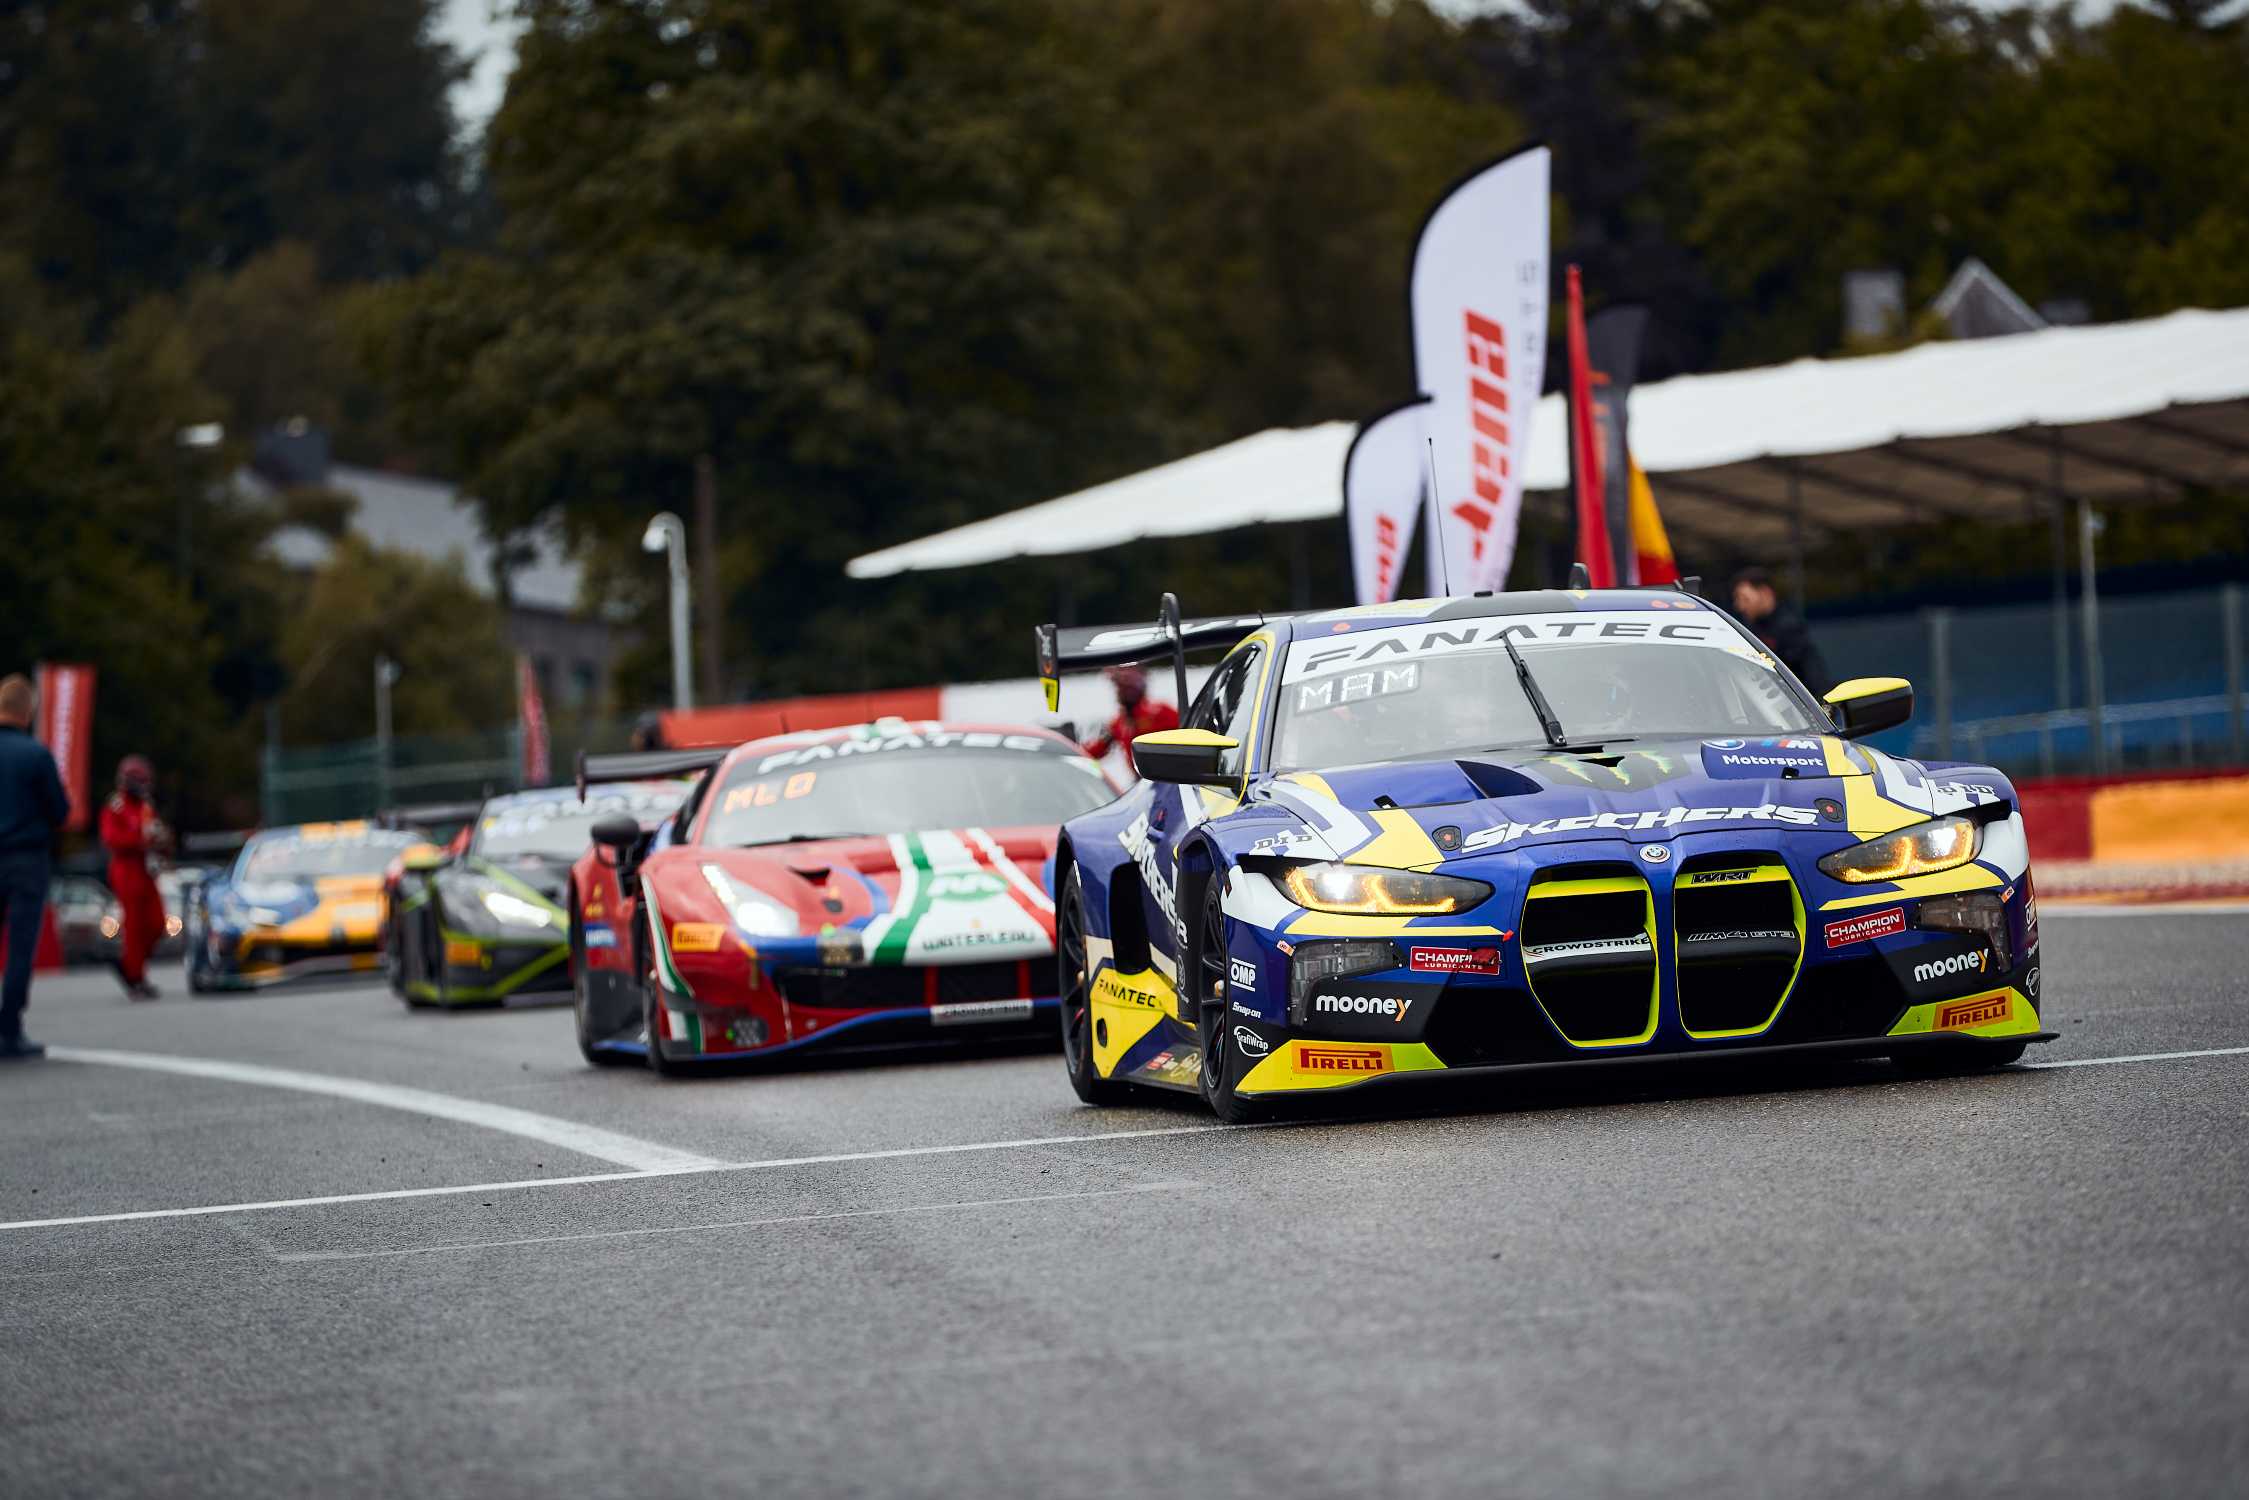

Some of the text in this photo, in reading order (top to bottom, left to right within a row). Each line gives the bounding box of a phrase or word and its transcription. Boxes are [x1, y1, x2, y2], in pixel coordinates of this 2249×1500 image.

[1303, 622, 1711, 673] FANATEC
[1722, 754, 1824, 767] Motorsport
[1461, 803, 1820, 853] SKECHERS
[1829, 913, 1900, 938] CHAMPION
[1840, 925, 1892, 942] LUBRICANTS
[1532, 937, 1652, 954] CROWDSTRIKE
[1230, 963, 1256, 986] OMP
[1914, 948, 1989, 982] mooney
[1099, 978, 1157, 1008] FANATEC
[1232, 1001, 1261, 1019] Snap-on
[1316, 994, 1413, 1022] mooney
[1941, 995, 2006, 1028] PIRELLI
[1236, 1031, 1269, 1051] GrafiWrap
[1300, 1047, 1383, 1070] PIRELLI
